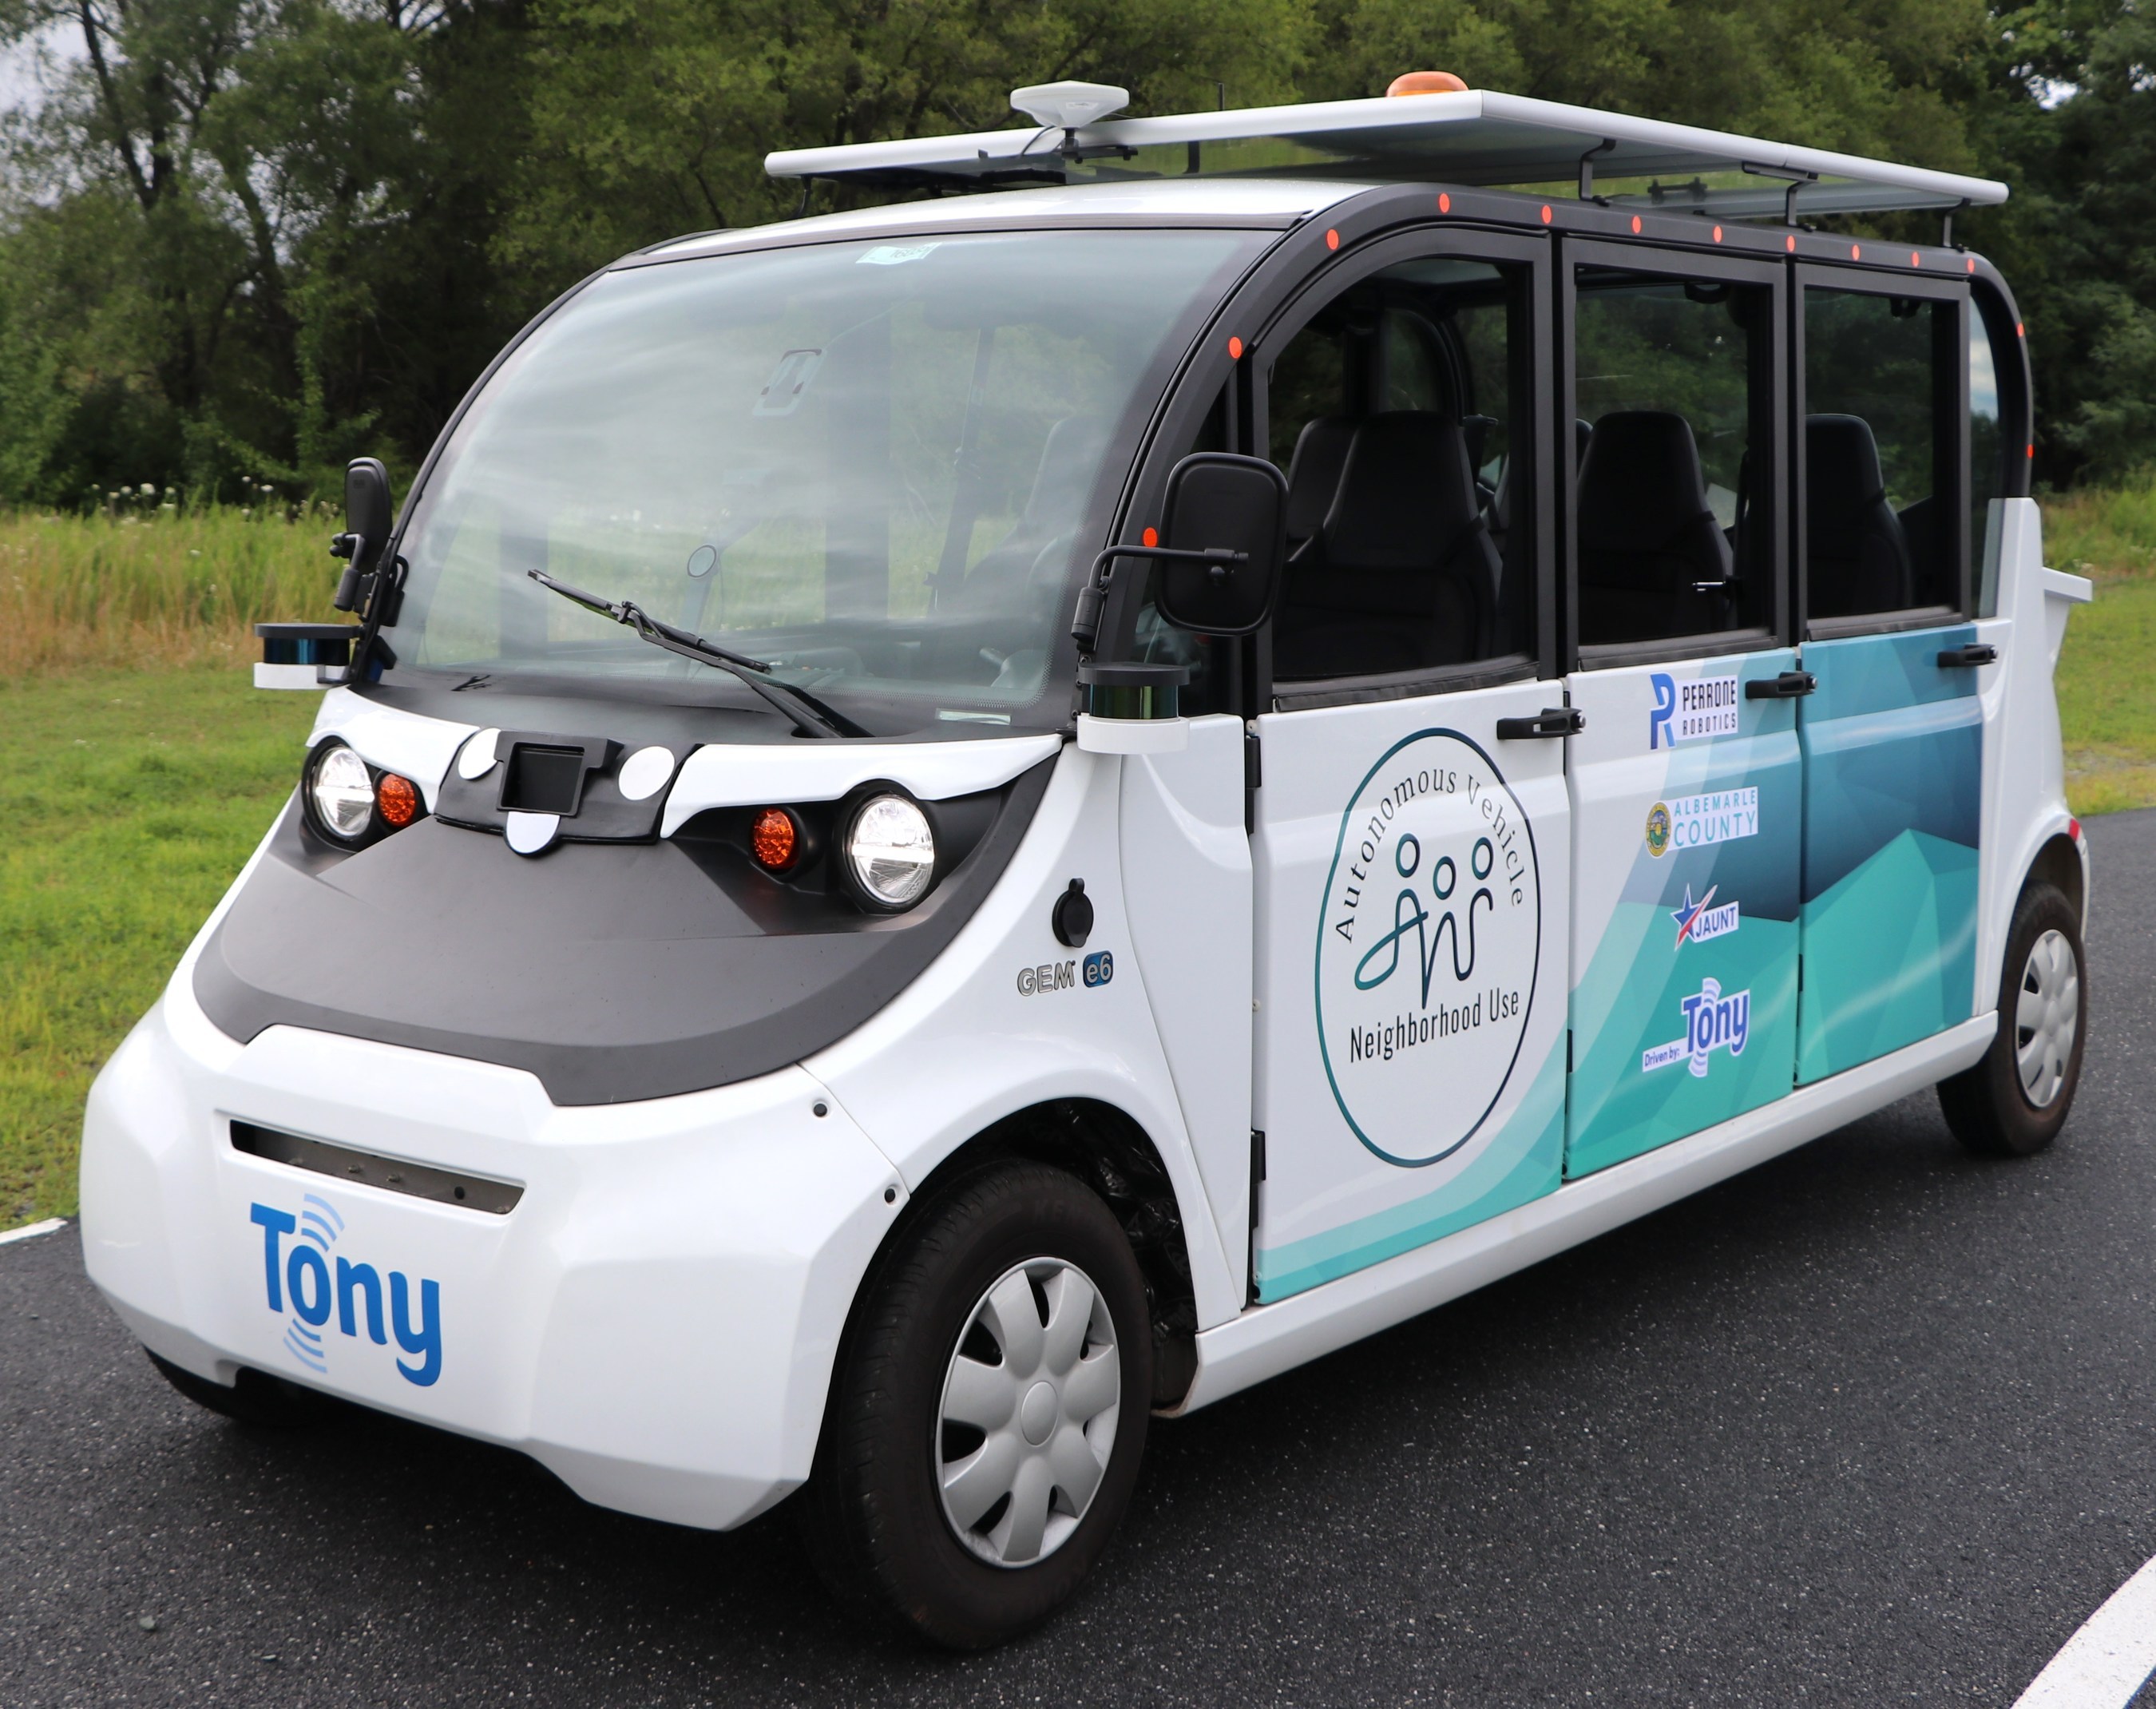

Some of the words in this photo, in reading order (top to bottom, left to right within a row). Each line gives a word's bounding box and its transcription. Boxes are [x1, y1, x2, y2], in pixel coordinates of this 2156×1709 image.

[1682, 680, 1736, 711] PERRONE
[1682, 712, 1736, 736] ROBOTICS
[1674, 790, 1756, 816] ALBEMARLE
[1674, 811, 1756, 847] COUNTY
[1335, 767, 1457, 943] Autonomous
[1468, 774, 1524, 906] Vehicle
[1696, 906, 1736, 938] JAUNT
[1017, 961, 1075, 997] GEM
[1086, 954, 1112, 983] e6
[1349, 993, 1481, 1063] Neighborhood
[1490, 989, 1520, 1024] Use
[1644, 1051, 1668, 1067] Driven
[1683, 994, 1749, 1053] Tony
[251, 1202, 442, 1387] Tony
